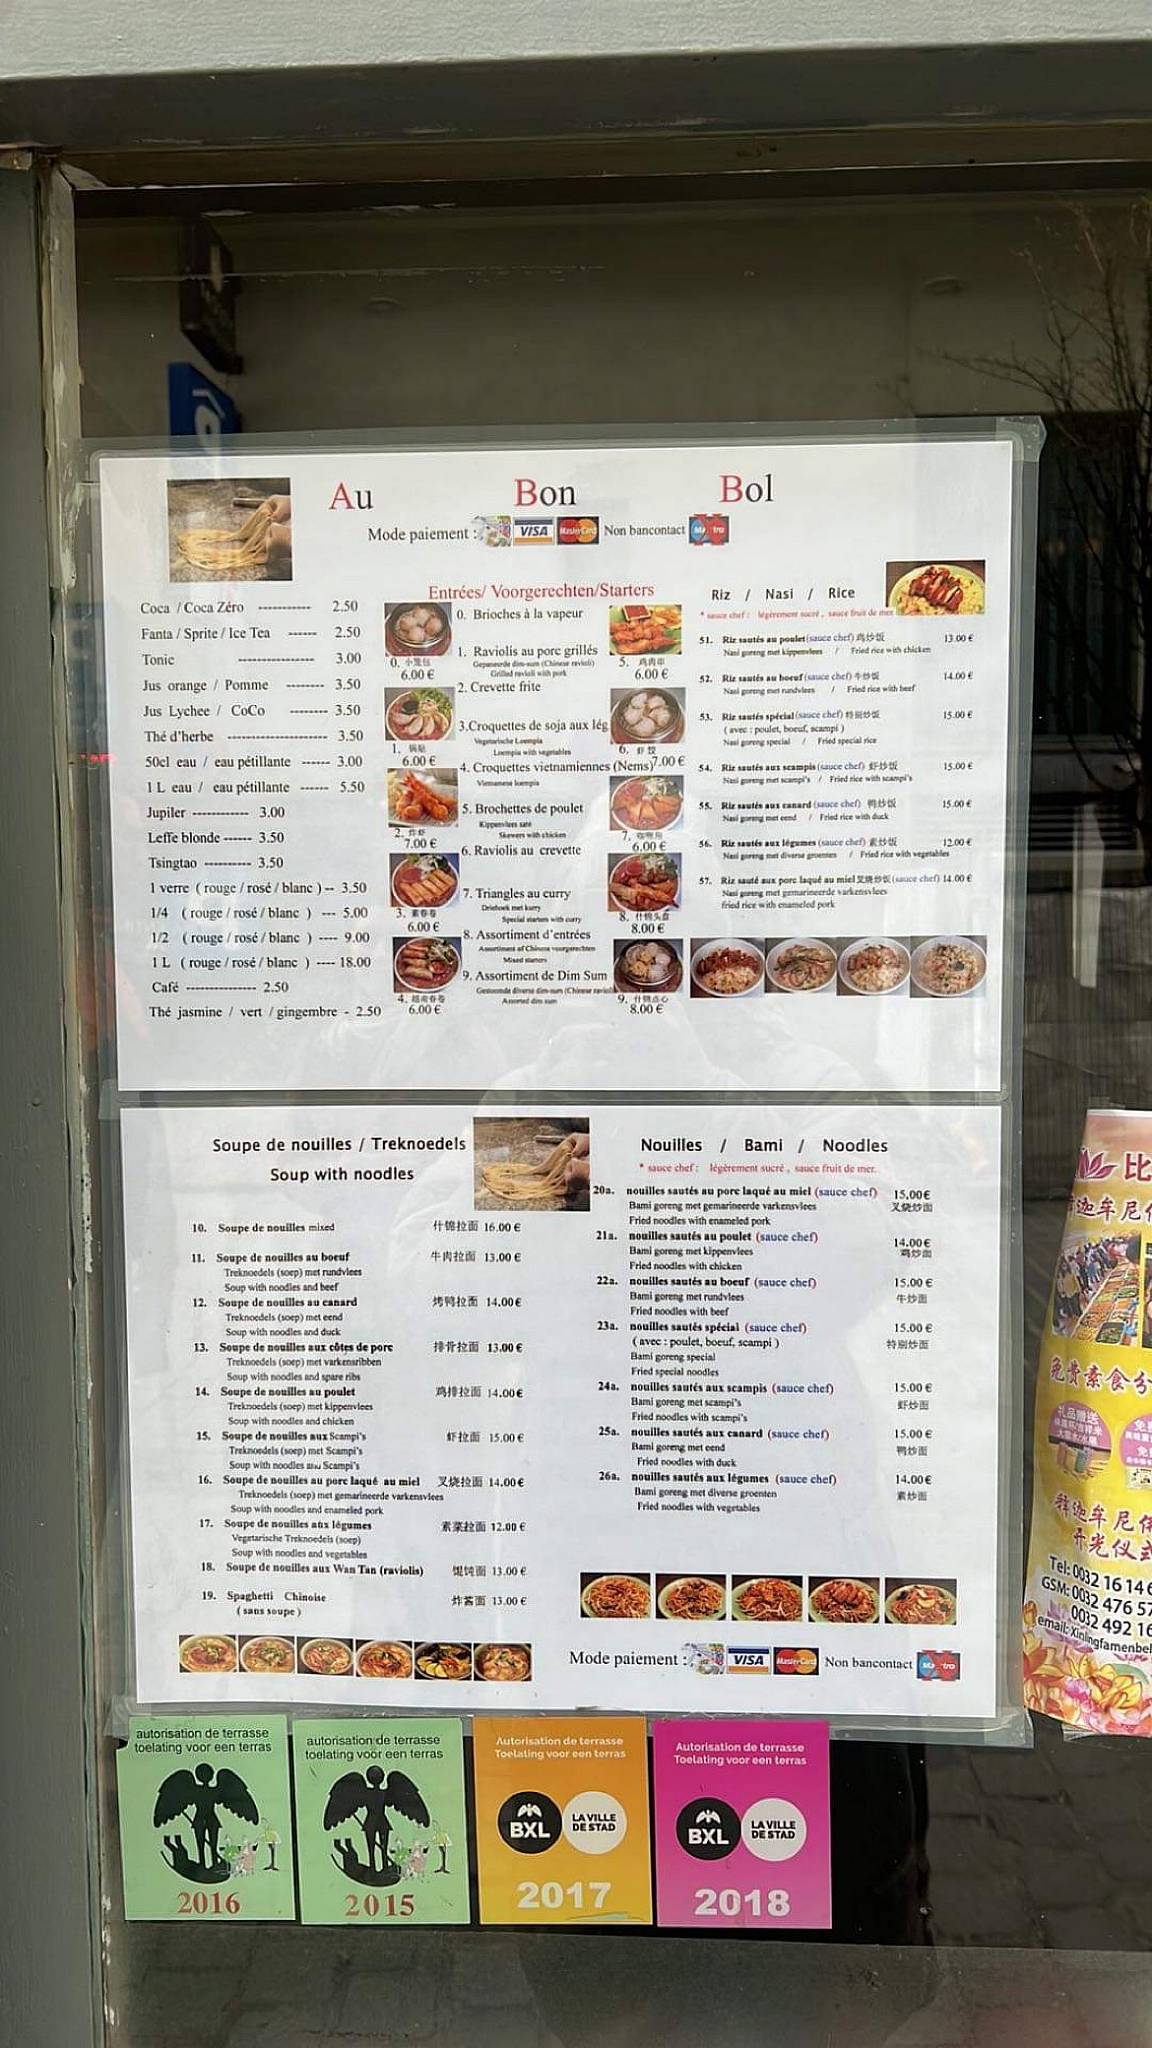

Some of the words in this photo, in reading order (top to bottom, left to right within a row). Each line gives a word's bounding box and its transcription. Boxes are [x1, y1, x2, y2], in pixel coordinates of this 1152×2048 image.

[328, 482, 374, 510] Au
[514, 478, 577, 507] Bon
[720, 474, 774, 503] Bol
[368, 527, 406, 541] Mode
[409, 529, 469, 544] paiement
[519, 525, 548, 536] VISA
[604, 525, 627, 535] Non
[629, 524, 685, 536] bancontact
[428, 585, 485, 599] Entrées/
[490, 582, 654, 600] Voorgerechten/Starters
[711, 588, 730, 600] Riz
[765, 588, 793, 599] Nasi
[828, 586, 855, 598] Rice
[140, 602, 169, 614] Coca
[183, 601, 213, 613] Coca
[216, 600, 243, 612] Zéro
[332, 600, 358, 612] 2.50
[456, 609, 465, 619] 0.
[473, 608, 521, 619] Brioches
[533, 607, 543, 618] la
[546, 609, 583, 621] vapeur
[400, 669, 424, 680] 6.00
[426, 668, 434, 679] €
[143, 730, 166, 742] Thé
[169, 730, 213, 742] d'herbe
[338, 729, 363, 741] 3.50
[699, 801, 712, 810] 55.
[721, 801, 735, 809] Riz
[737, 801, 763, 809] sautés
[782, 800, 811, 808] canard
[813, 799, 838, 810] (sauce
[840, 799, 861, 809] chef)
[942, 799, 964, 809] 15.00
[148, 832, 179, 843] Leffe
[181, 832, 220, 843] blonde
[258, 831, 284, 843] 3.50
[462, 971, 472, 981] 9.
[475, 969, 538, 981] Assortiment
[541, 970, 554, 980] de
[557, 969, 580, 981] Dim
[583, 970, 607, 980] Sum
[212, 1138, 260, 1154] Soupe
[266, 1137, 285, 1151] de
[291, 1137, 351, 1151] nouilles
[370, 1136, 465, 1150] Treknoedels
[641, 1137, 702, 1151] Nouilles
[744, 1138, 782, 1151] Bami
[823, 1138, 887, 1152] Noodles
[270, 1167, 309, 1183] Soup
[314, 1167, 347, 1180] with
[354, 1166, 414, 1180] noodles
[192, 1223, 206, 1232] 10.
[218, 1223, 249, 1234] Soupe
[251, 1222, 264, 1232] de
[266, 1222, 305, 1232] nouilles
[308, 1222, 334, 1231] mixed
[484, 1222, 511, 1231] 16.00
[513, 1222, 520, 1231] €
[596, 1230, 617, 1240] 21a.
[628, 1230, 667, 1240] nouilles
[670, 1230, 701, 1240] sautés
[719, 1230, 751, 1243] poulet
[755, 1231, 788, 1242] (sauce
[791, 1231, 818, 1243] chef)
[629, 1260, 651, 1270] Fried
[653, 1261, 686, 1270] noodles
[688, 1261, 707, 1270] with
[708, 1261, 742, 1270] chicken
[1049, 1555, 1071, 1576] Tel:
[1072, 1564, 1100, 1588] 0032
[1104, 1575, 1122, 1592] 16
[1126, 1579, 1145, 1595] 14
[1041, 1576, 1070, 1597] GSM:
[1071, 1585, 1099, 1610] 0032
[1102, 1597, 1133, 1615] 476
[1037, 1615, 1068, 1634] email:
[1071, 1604, 1099, 1630] 0032
[1102, 1618, 1132, 1636] 492
[569, 1652, 610, 1665] Mode
[613, 1651, 679, 1668] paiement
[732, 1655, 765, 1666] VISA
[825, 1657, 850, 1668] Non
[852, 1657, 913, 1670] bancontact
[136, 1727, 202, 1739] autorisation
[204, 1727, 219, 1739] de
[222, 1727, 270, 1739] terrasse
[305, 1735, 372, 1747] autorisation
[375, 1733, 391, 1746] de
[394, 1735, 440, 1746] terrasse
[496, 1736, 560, 1746] Autorisation
[562, 1737, 578, 1746] de
[579, 1737, 624, 1746] terrasse
[134, 1741, 182, 1754] toelating
[185, 1743, 211, 1753] voor
[214, 1743, 235, 1753] een
[238, 1741, 272, 1753] terras
[304, 1746, 355, 1762] toelating
[356, 1748, 382, 1759] voor
[383, 1749, 407, 1759] een
[410, 1748, 443, 1759] terras
[676, 1743, 741, 1752] Autorisation
[741, 1743, 757, 1752] de
[759, 1744, 804, 1753] terrasse
[494, 1749, 544, 1760] Toelating
[593, 1749, 626, 1759] terras
[674, 1755, 724, 1766] Toelating
[725, 1756, 750, 1765] voor
[752, 1756, 772, 1765] een
[774, 1755, 806, 1766] terras
[572, 1813, 586, 1822] LA
[587, 1813, 616, 1822] VILLE
[510, 1822, 551, 1839] BXL
[573, 1823, 586, 1832] DE
[588, 1823, 616, 1832] STAD
[751, 1820, 765, 1829] LA
[766, 1820, 795, 1830] VILLE
[688, 1829, 729, 1844] BXL
[751, 1830, 765, 1839] DE
[766, 1830, 795, 1839] STAD
[517, 1881, 611, 1909] 2017
[177, 1892, 240, 1915] 2016
[345, 1894, 414, 1916] 2015
[694, 1889, 791, 1916] 2018
